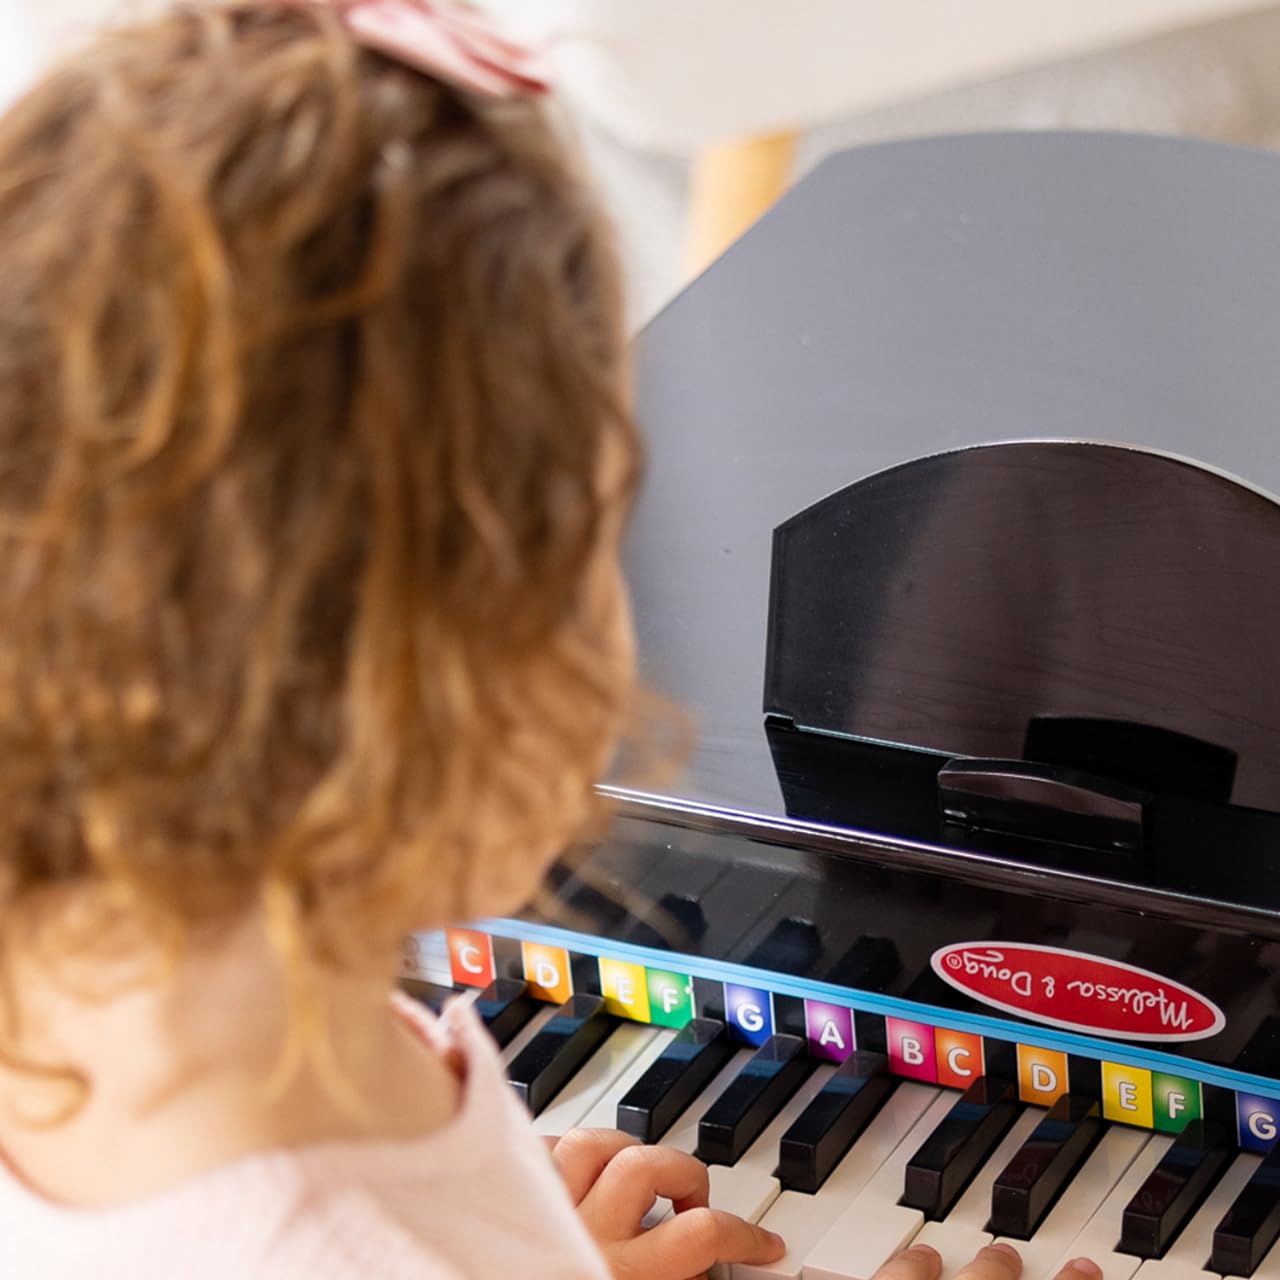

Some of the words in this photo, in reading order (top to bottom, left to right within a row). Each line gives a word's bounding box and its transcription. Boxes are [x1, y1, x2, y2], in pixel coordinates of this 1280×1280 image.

[1041, 975, 1055, 998] &
[1066, 980, 1194, 1030] Melissa
[459, 943, 483, 974] C
[535, 961, 560, 988] D
[616, 976, 635, 1006] E
[660, 987, 679, 1014] F
[736, 1002, 764, 1033] G
[819, 1020, 846, 1049] A
[902, 1035, 925, 1066] B
[946, 1046, 973, 1077] C
[1031, 1063, 1058, 1093] D
[1118, 1082, 1138, 1112] E
[1167, 1091, 1187, 1119] F
[1247, 1111, 1277, 1141] G
